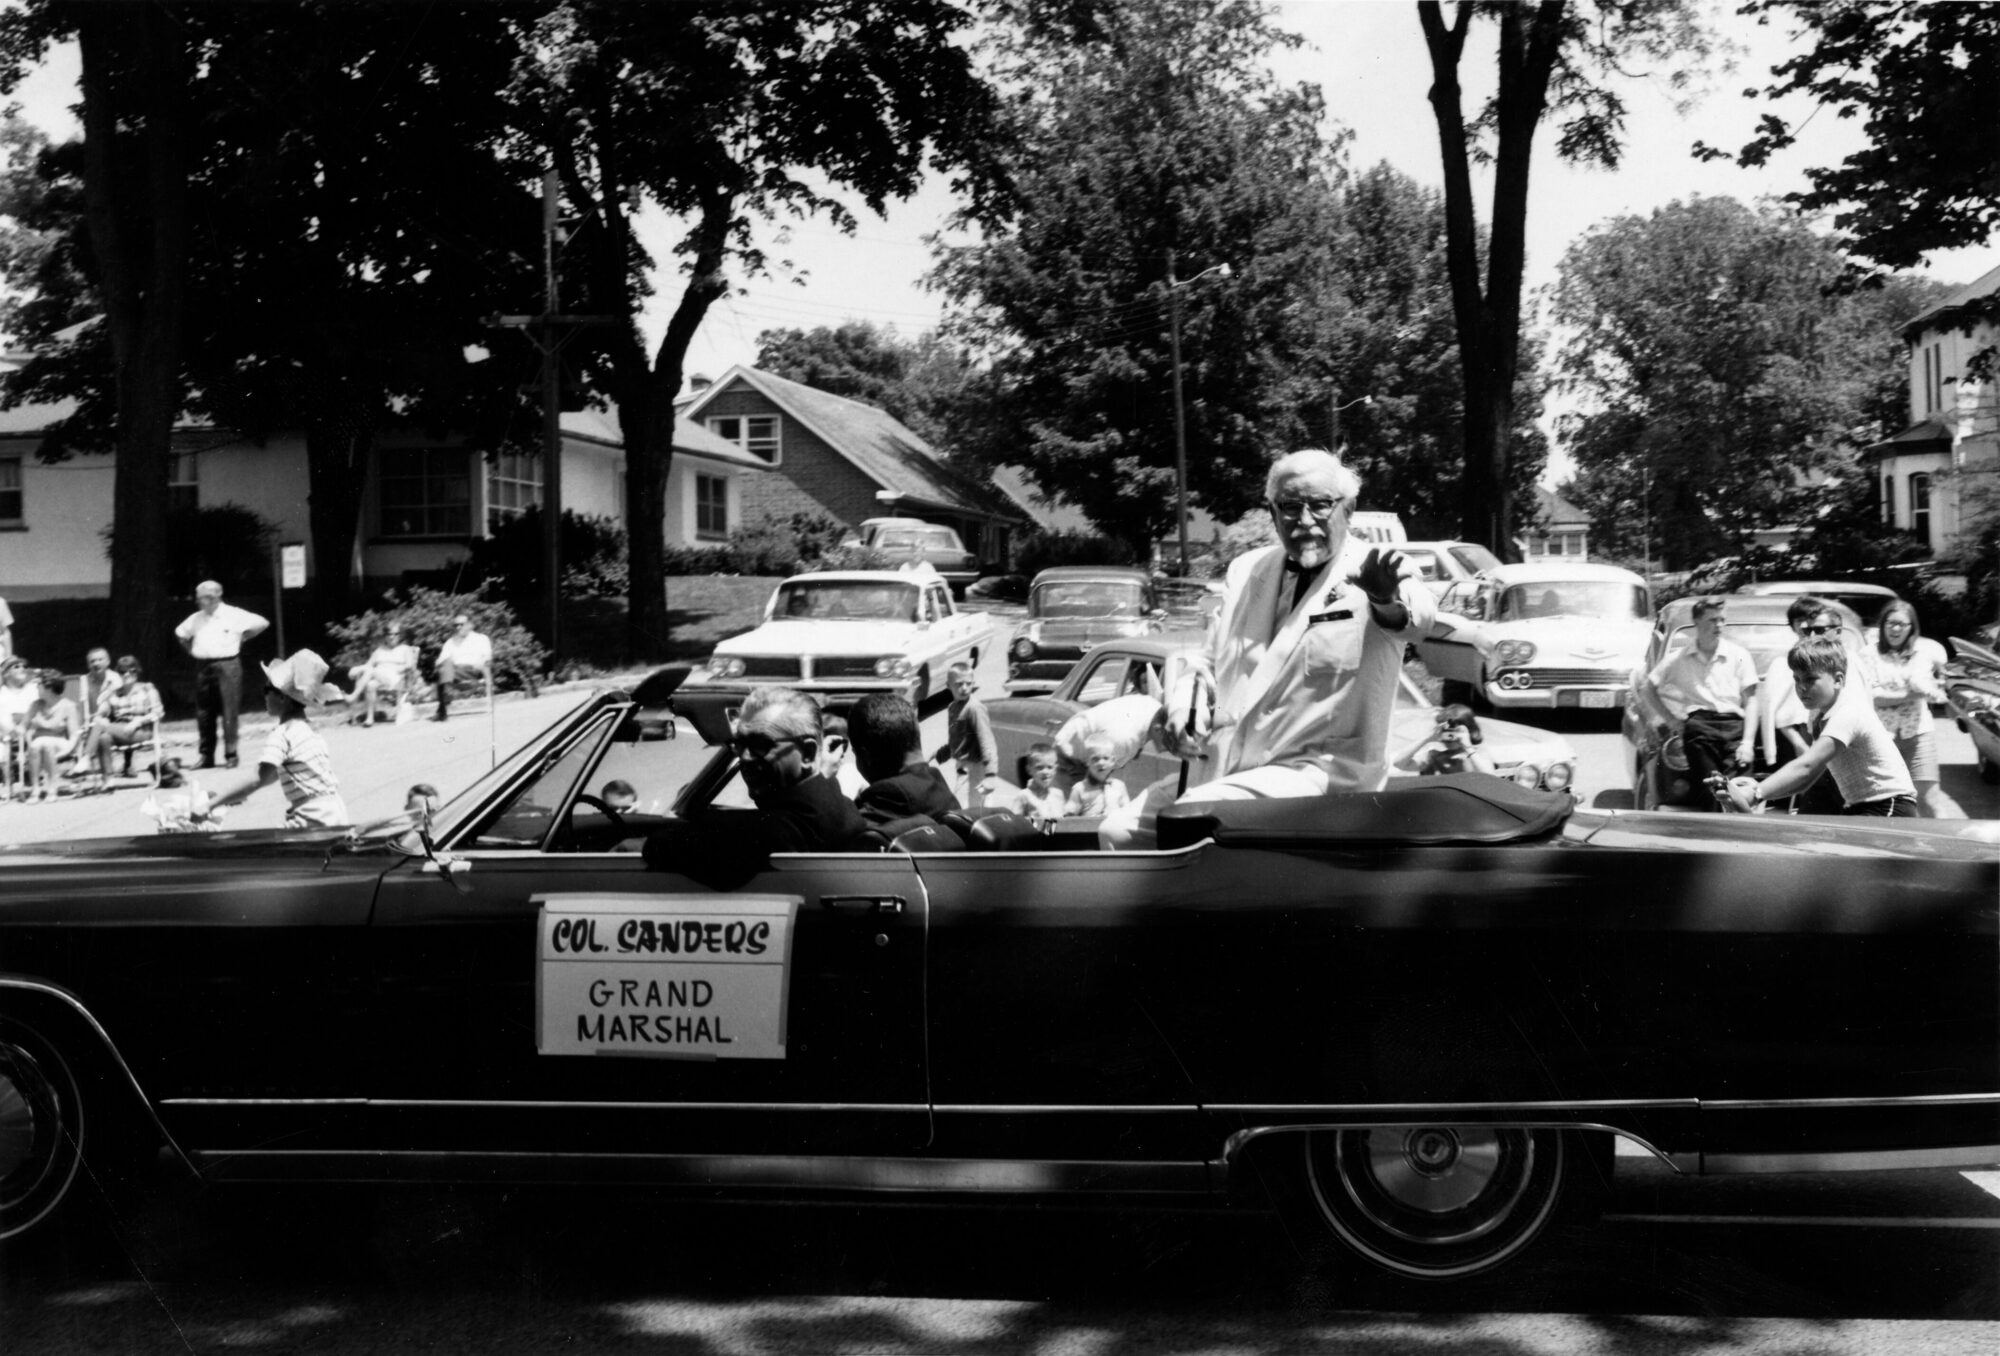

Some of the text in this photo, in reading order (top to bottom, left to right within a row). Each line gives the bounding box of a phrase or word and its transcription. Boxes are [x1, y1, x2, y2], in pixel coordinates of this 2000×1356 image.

[552, 919, 769, 955] COL. SANDERS
[589, 979, 713, 1007] GRAND
[577, 1014, 732, 1043] MARSHAL
